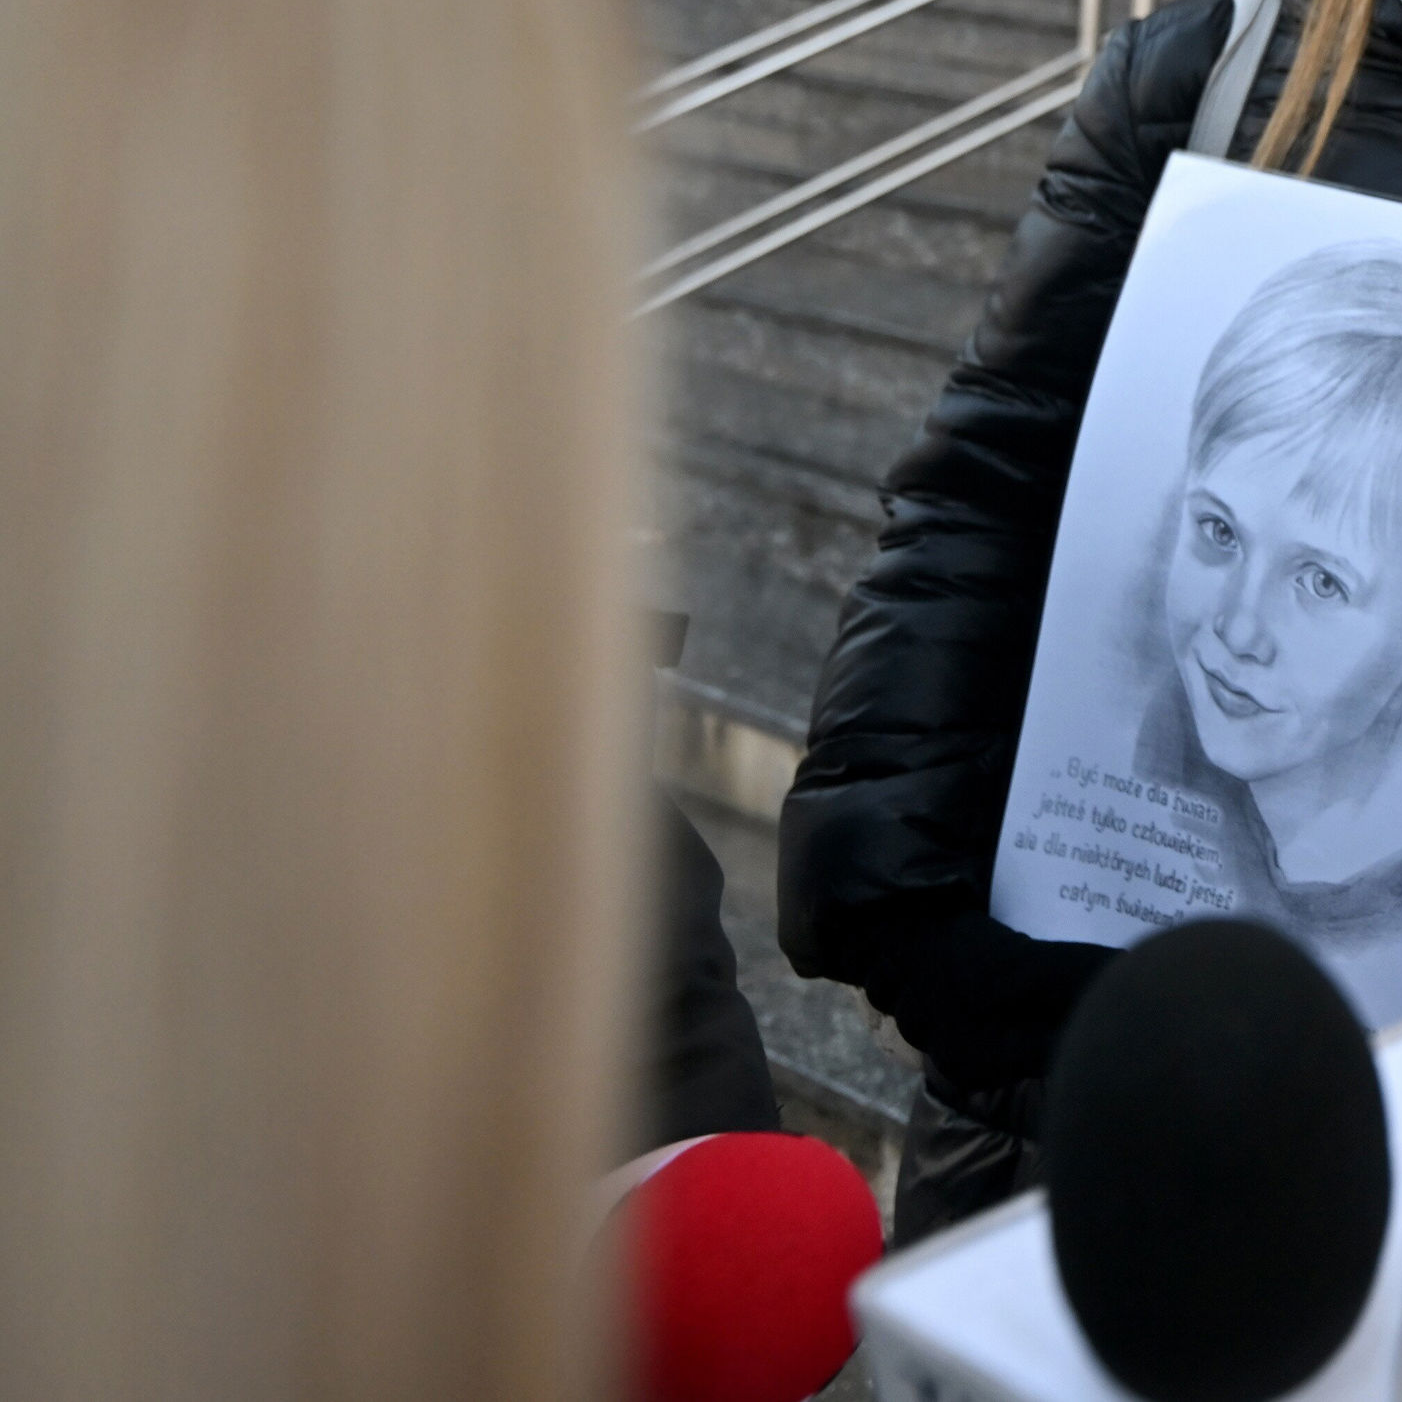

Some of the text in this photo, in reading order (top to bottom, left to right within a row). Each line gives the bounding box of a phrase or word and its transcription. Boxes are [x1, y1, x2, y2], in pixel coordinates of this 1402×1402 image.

[1103, 772, 1142, 797] może
[1147, 782, 1168, 806] dla
[1172, 791, 1219, 824] świata
[1033, 793, 1223, 870] jesteś tylko człowiekiem,
[1014, 827, 1234, 910] ale dla niektórych ludzi jesteś
[1059, 881, 1110, 912] całym
